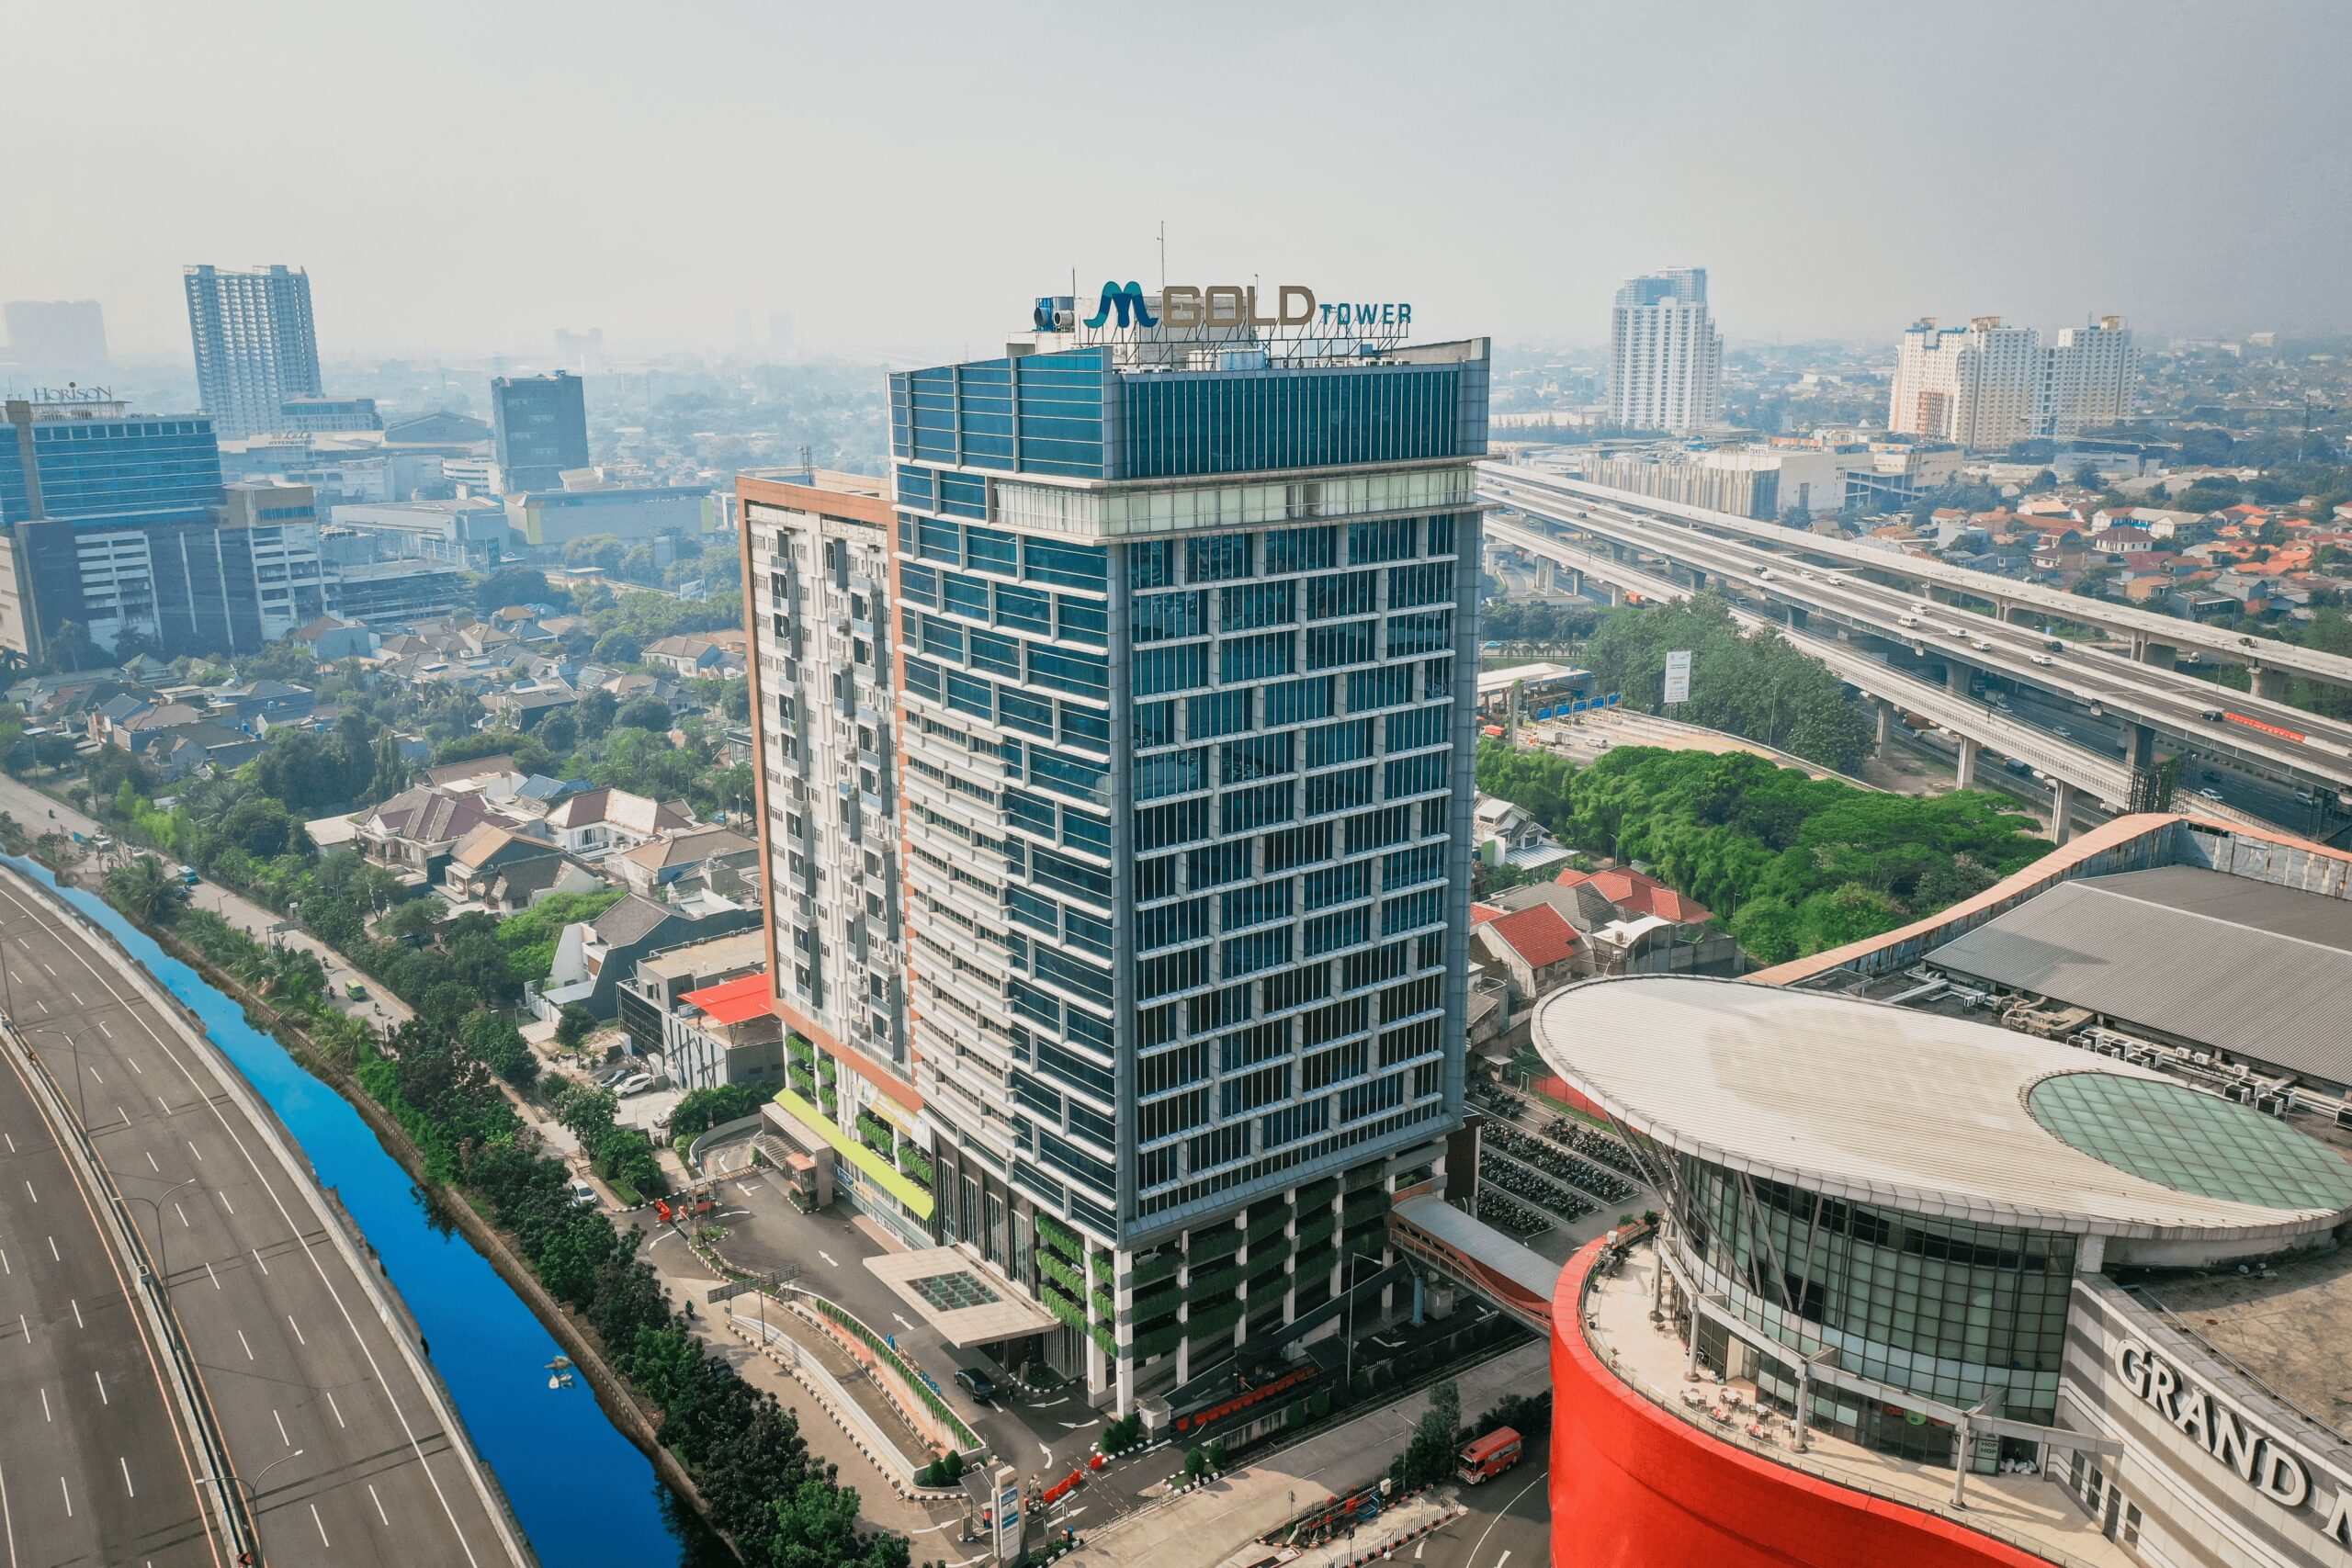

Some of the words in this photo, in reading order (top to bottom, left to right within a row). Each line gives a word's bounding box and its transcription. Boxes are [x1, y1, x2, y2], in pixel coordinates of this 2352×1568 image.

[1162, 286, 1317, 329] GOLD
[1319, 302, 1411, 325] TOWER
[2115, 1337, 2312, 1507] GRAND
